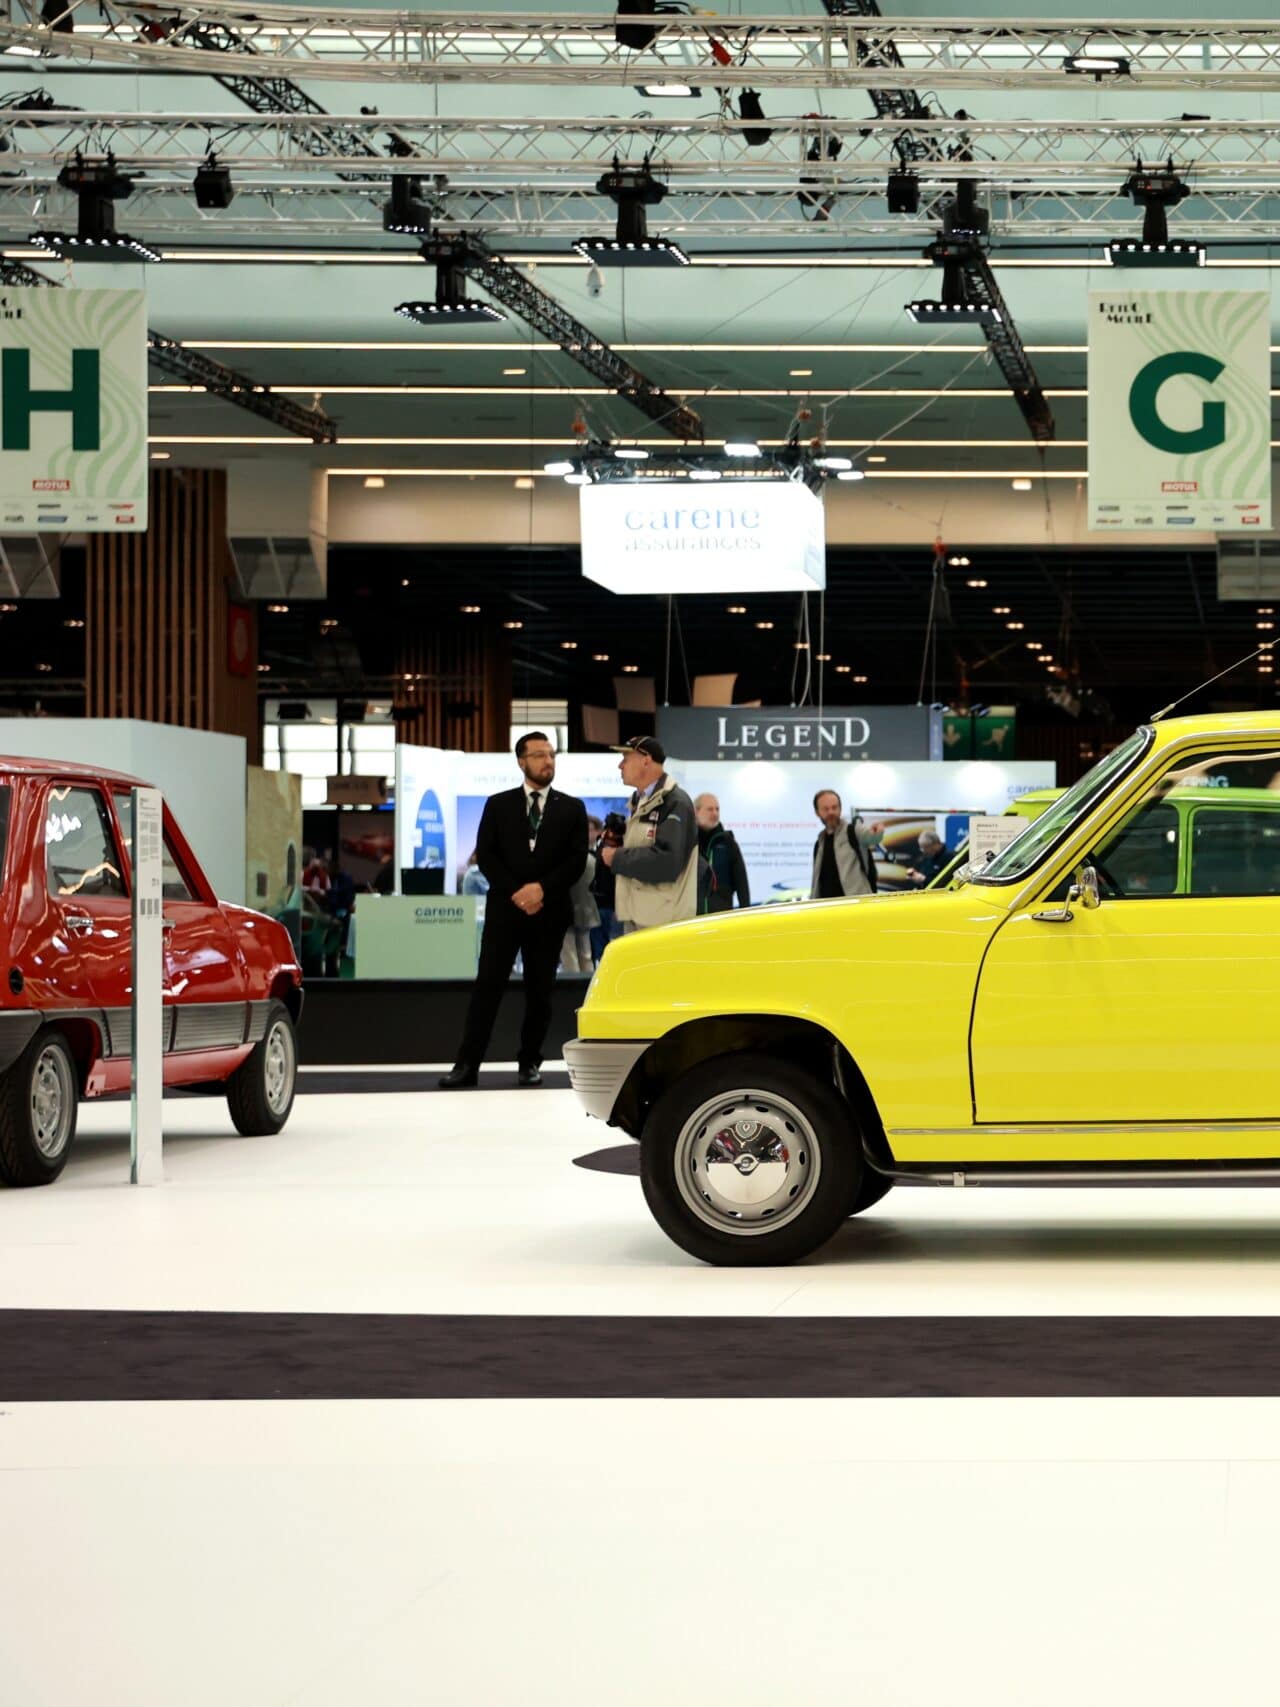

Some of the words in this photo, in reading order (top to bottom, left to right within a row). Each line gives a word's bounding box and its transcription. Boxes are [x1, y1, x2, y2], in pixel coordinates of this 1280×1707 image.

[2, 348, 100, 451] H
[1129, 351, 1226, 455] G
[1162, 482, 1197, 491] MOTUL
[625, 536, 761, 551] assurances
[415, 906, 464, 917] carene
